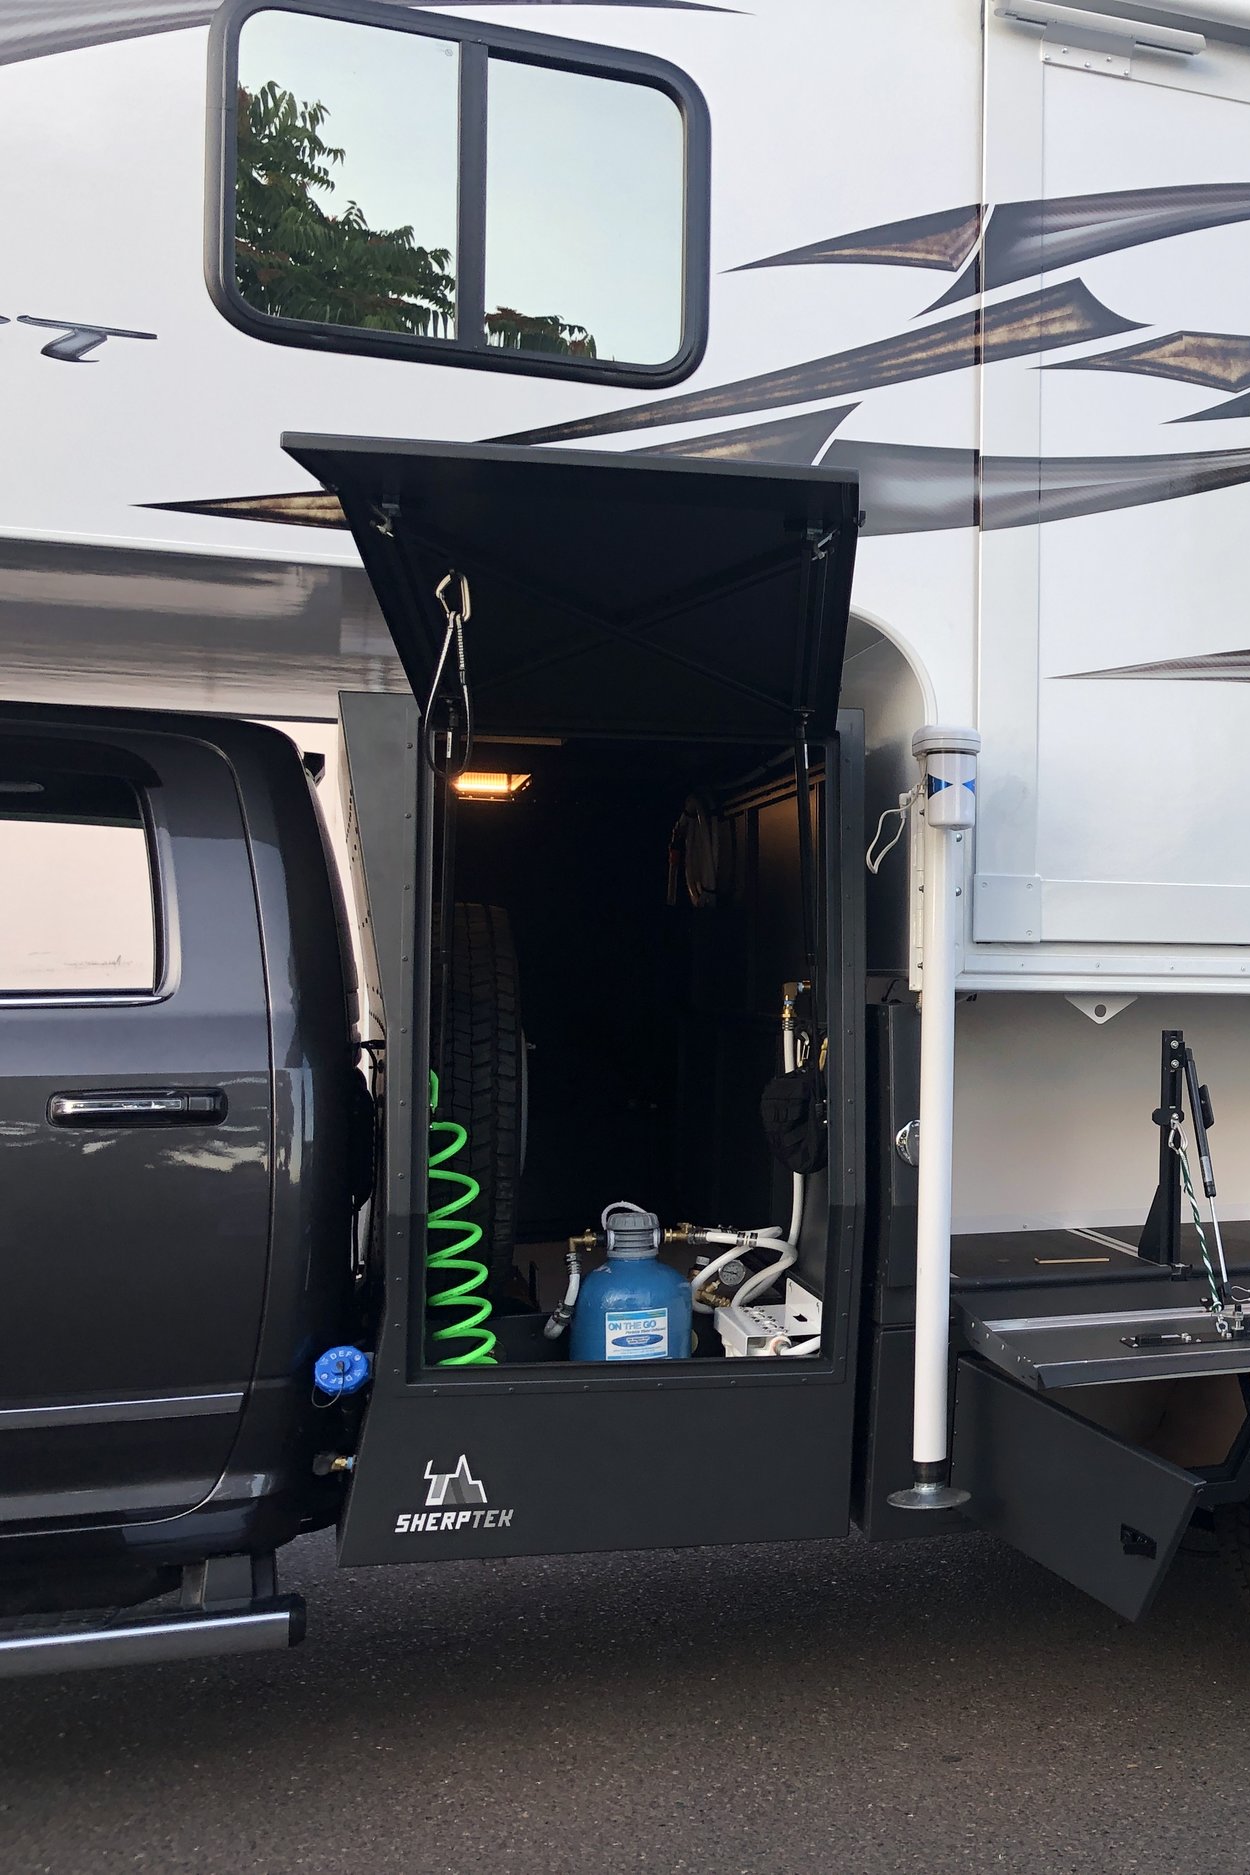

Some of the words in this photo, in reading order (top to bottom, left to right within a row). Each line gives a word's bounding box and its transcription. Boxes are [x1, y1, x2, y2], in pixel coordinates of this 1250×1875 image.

[608, 1322, 622, 1331] ON
[624, 1321, 641, 1330] THE
[643, 1320, 657, 1329] GO
[330, 1350, 353, 1360] DEF
[394, 1509, 515, 1533] SHERPTEK
